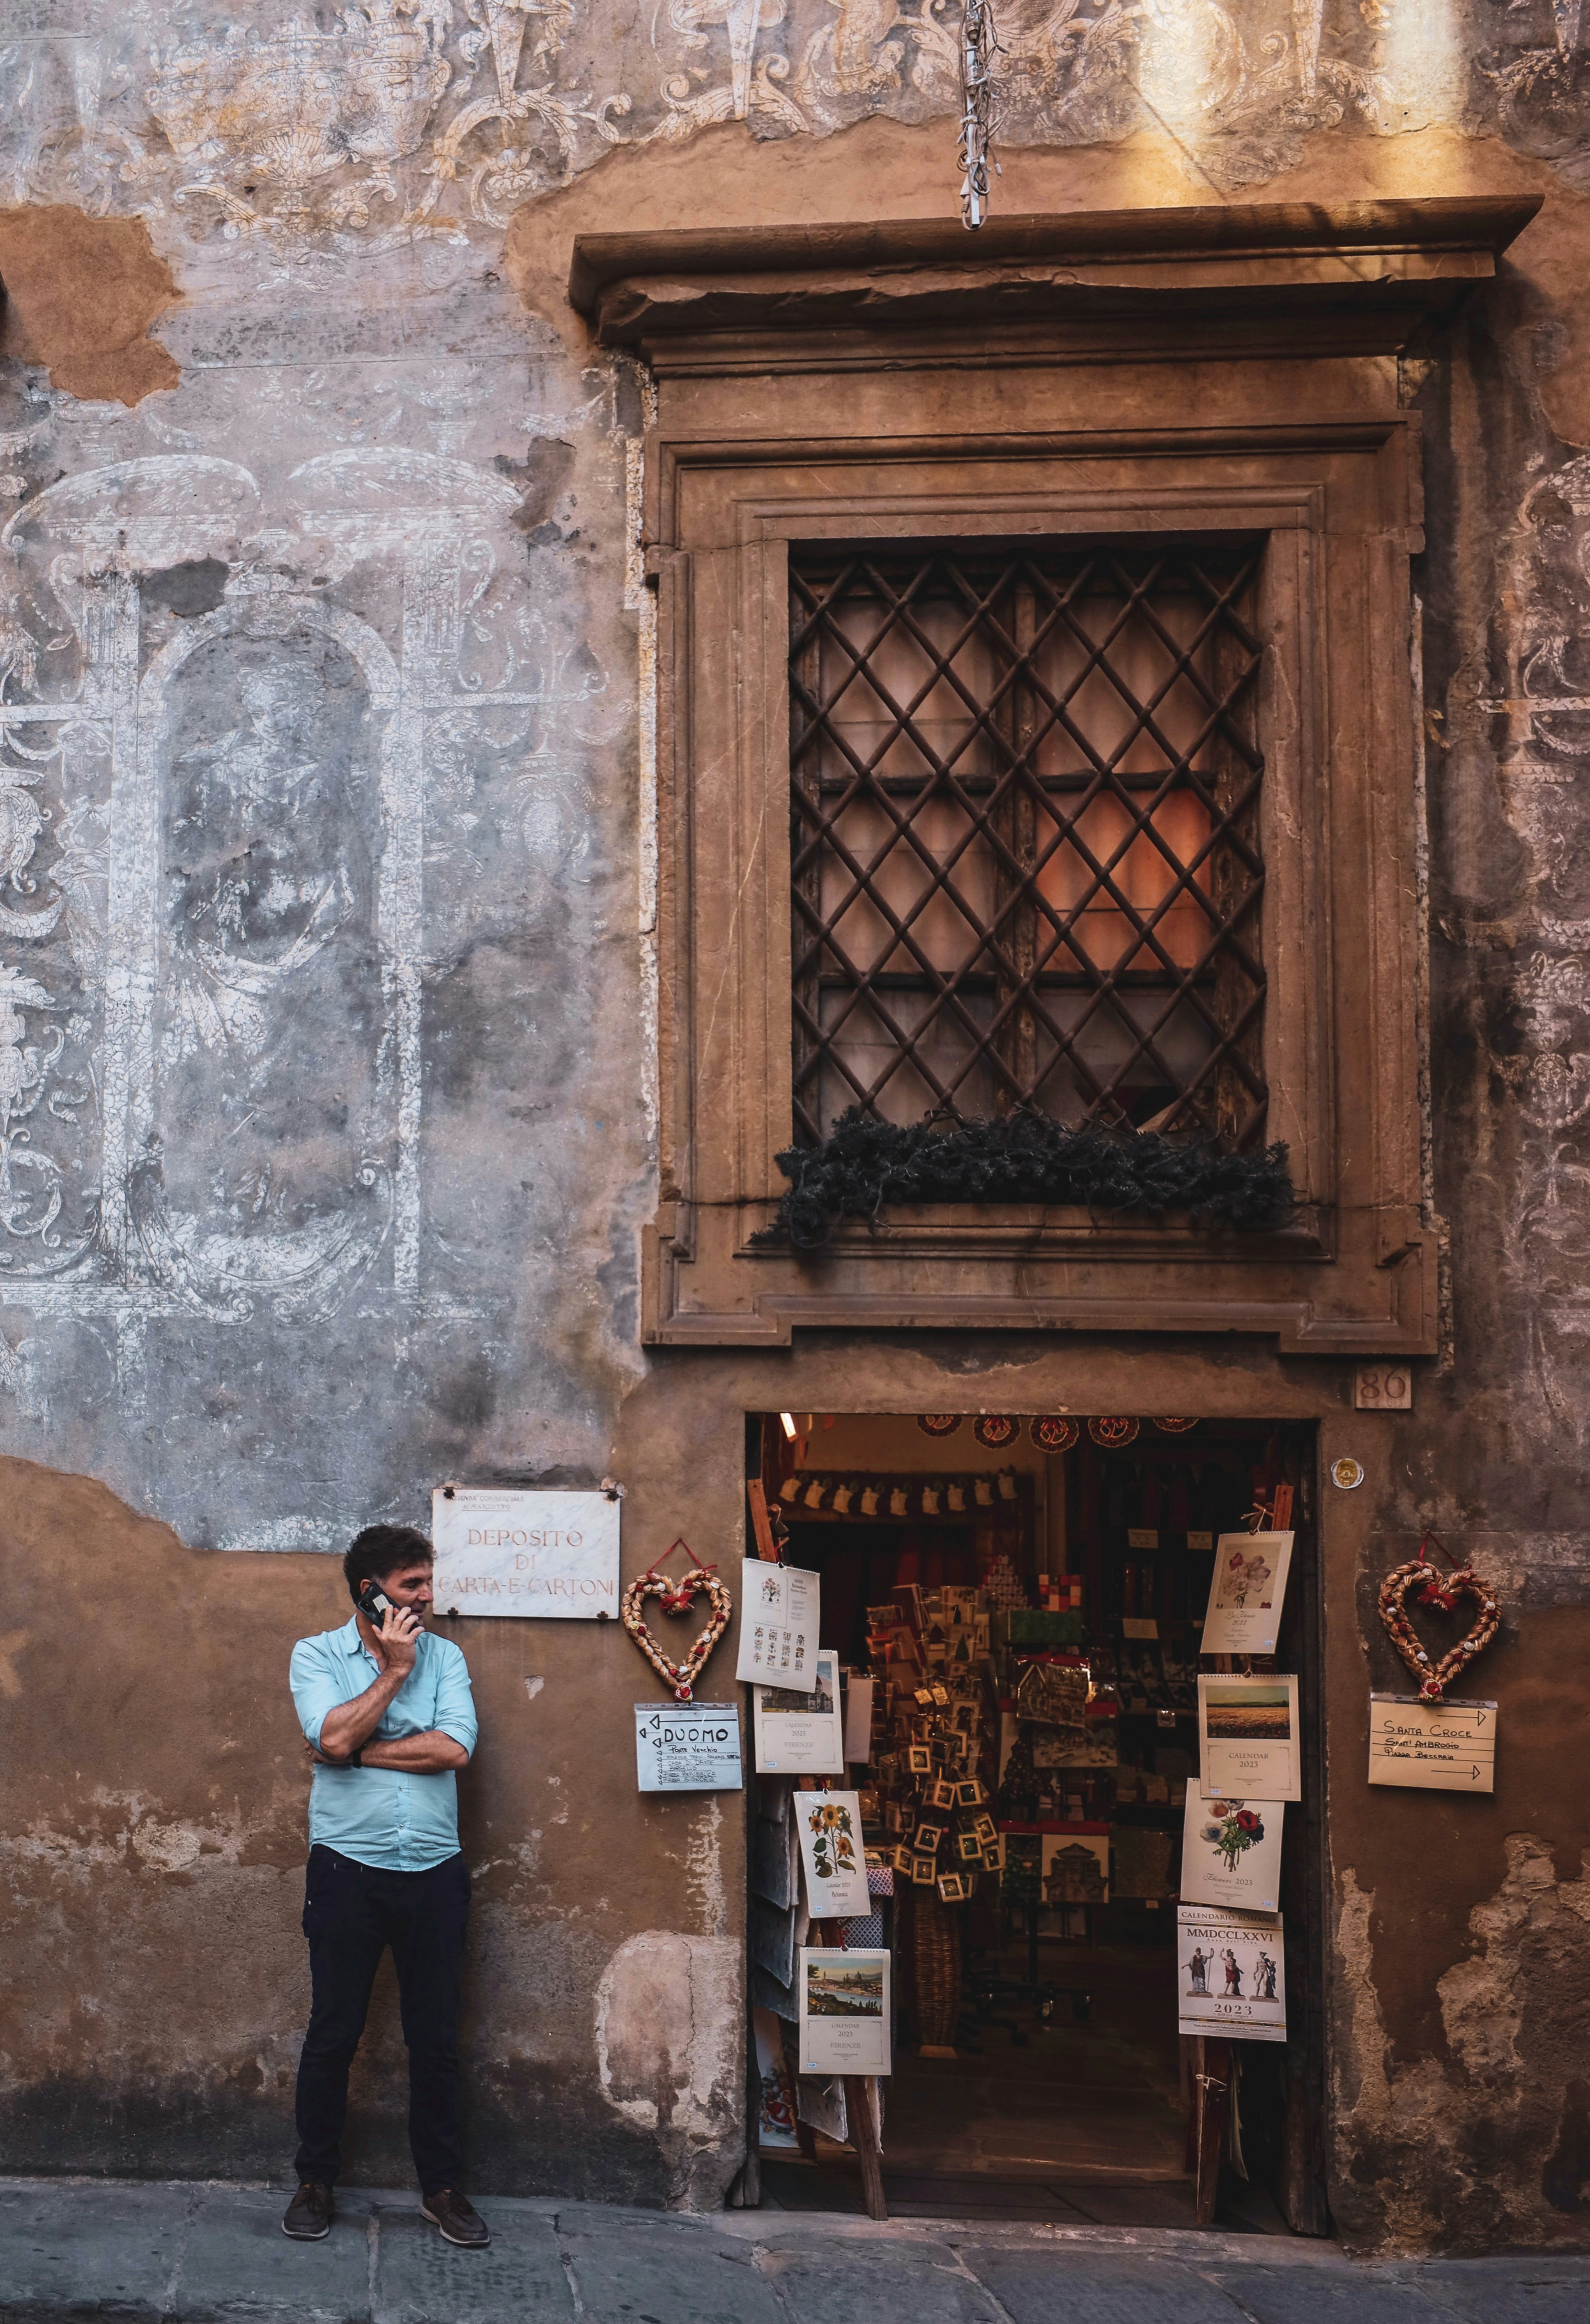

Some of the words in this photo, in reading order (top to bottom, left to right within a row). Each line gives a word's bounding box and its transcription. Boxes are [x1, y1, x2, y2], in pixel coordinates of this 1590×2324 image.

[1360, 1368, 1406, 1398] 86
[469, 1529, 583, 1547] DEPOSITO
[516, 1554, 535, 1570] DI
[665, 1728, 728, 1742] DUOMO
[1384, 1720, 1422, 1735] SANTA
[1430, 1725, 1472, 1738] CROCE
[1203, 1873, 1232, 1883] Flowers
[1182, 1912, 1235, 1921] CALENDARIO
[1187, 1928, 1273, 1942] MMDCCLXXVI
[1214, 2003, 1252, 2015] 2023
